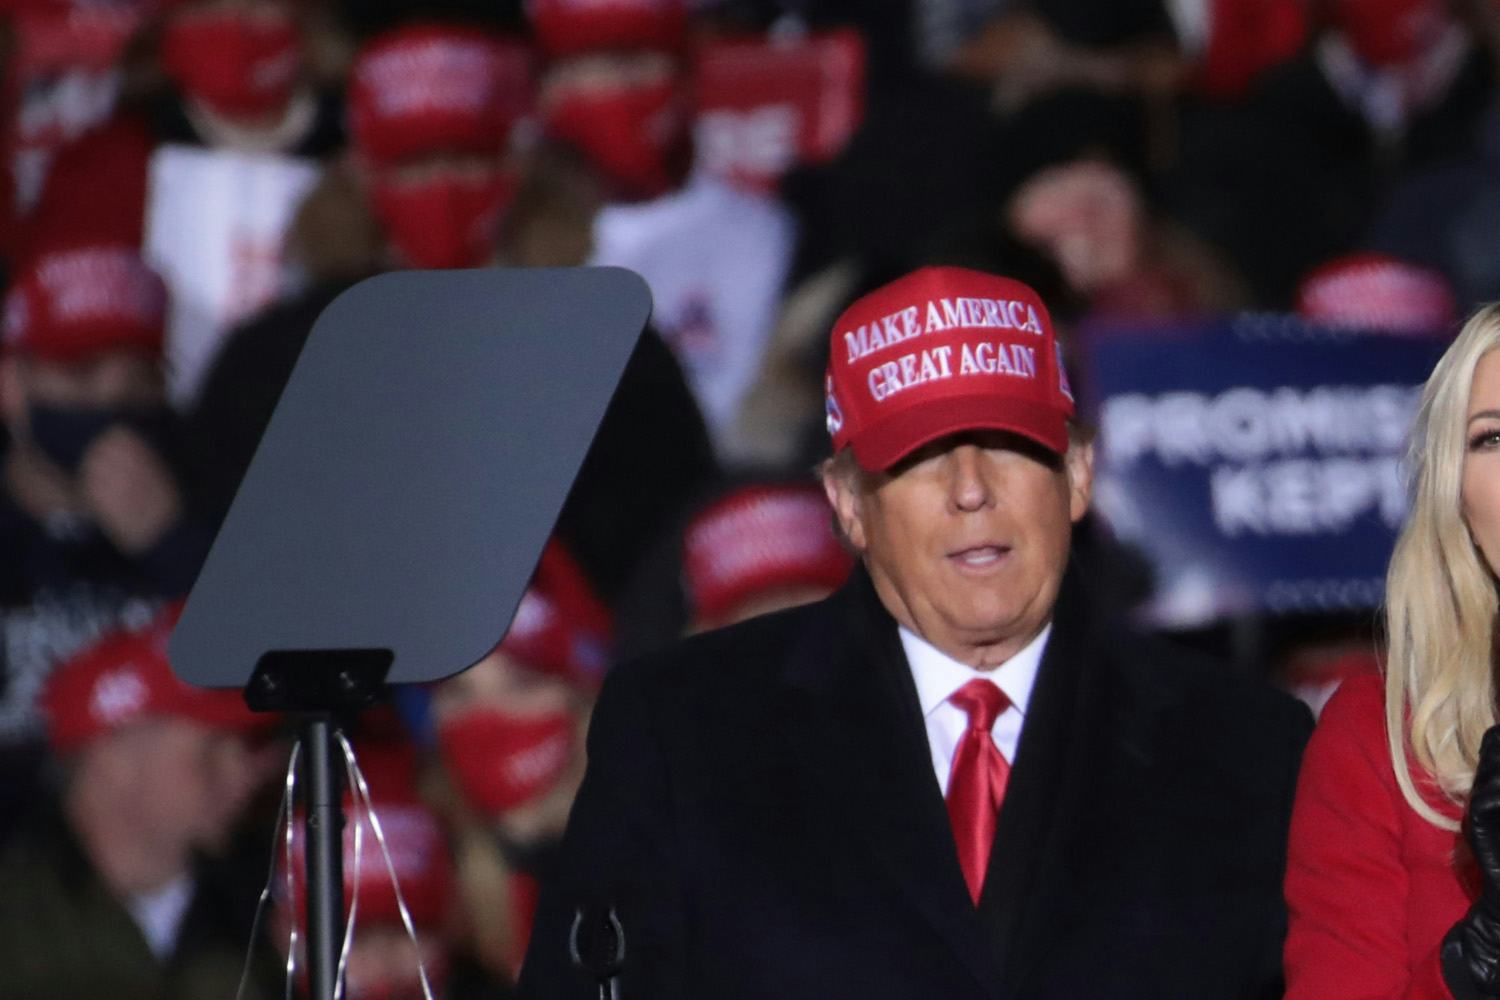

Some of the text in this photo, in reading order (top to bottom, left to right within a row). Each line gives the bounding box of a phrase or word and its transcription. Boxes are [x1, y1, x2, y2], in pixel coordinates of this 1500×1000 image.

[844, 297, 1042, 364] MAKE AMERICA
[868, 342, 1036, 402] GREAT AGAIN
[1104, 387, 1418, 463] PROMIS
